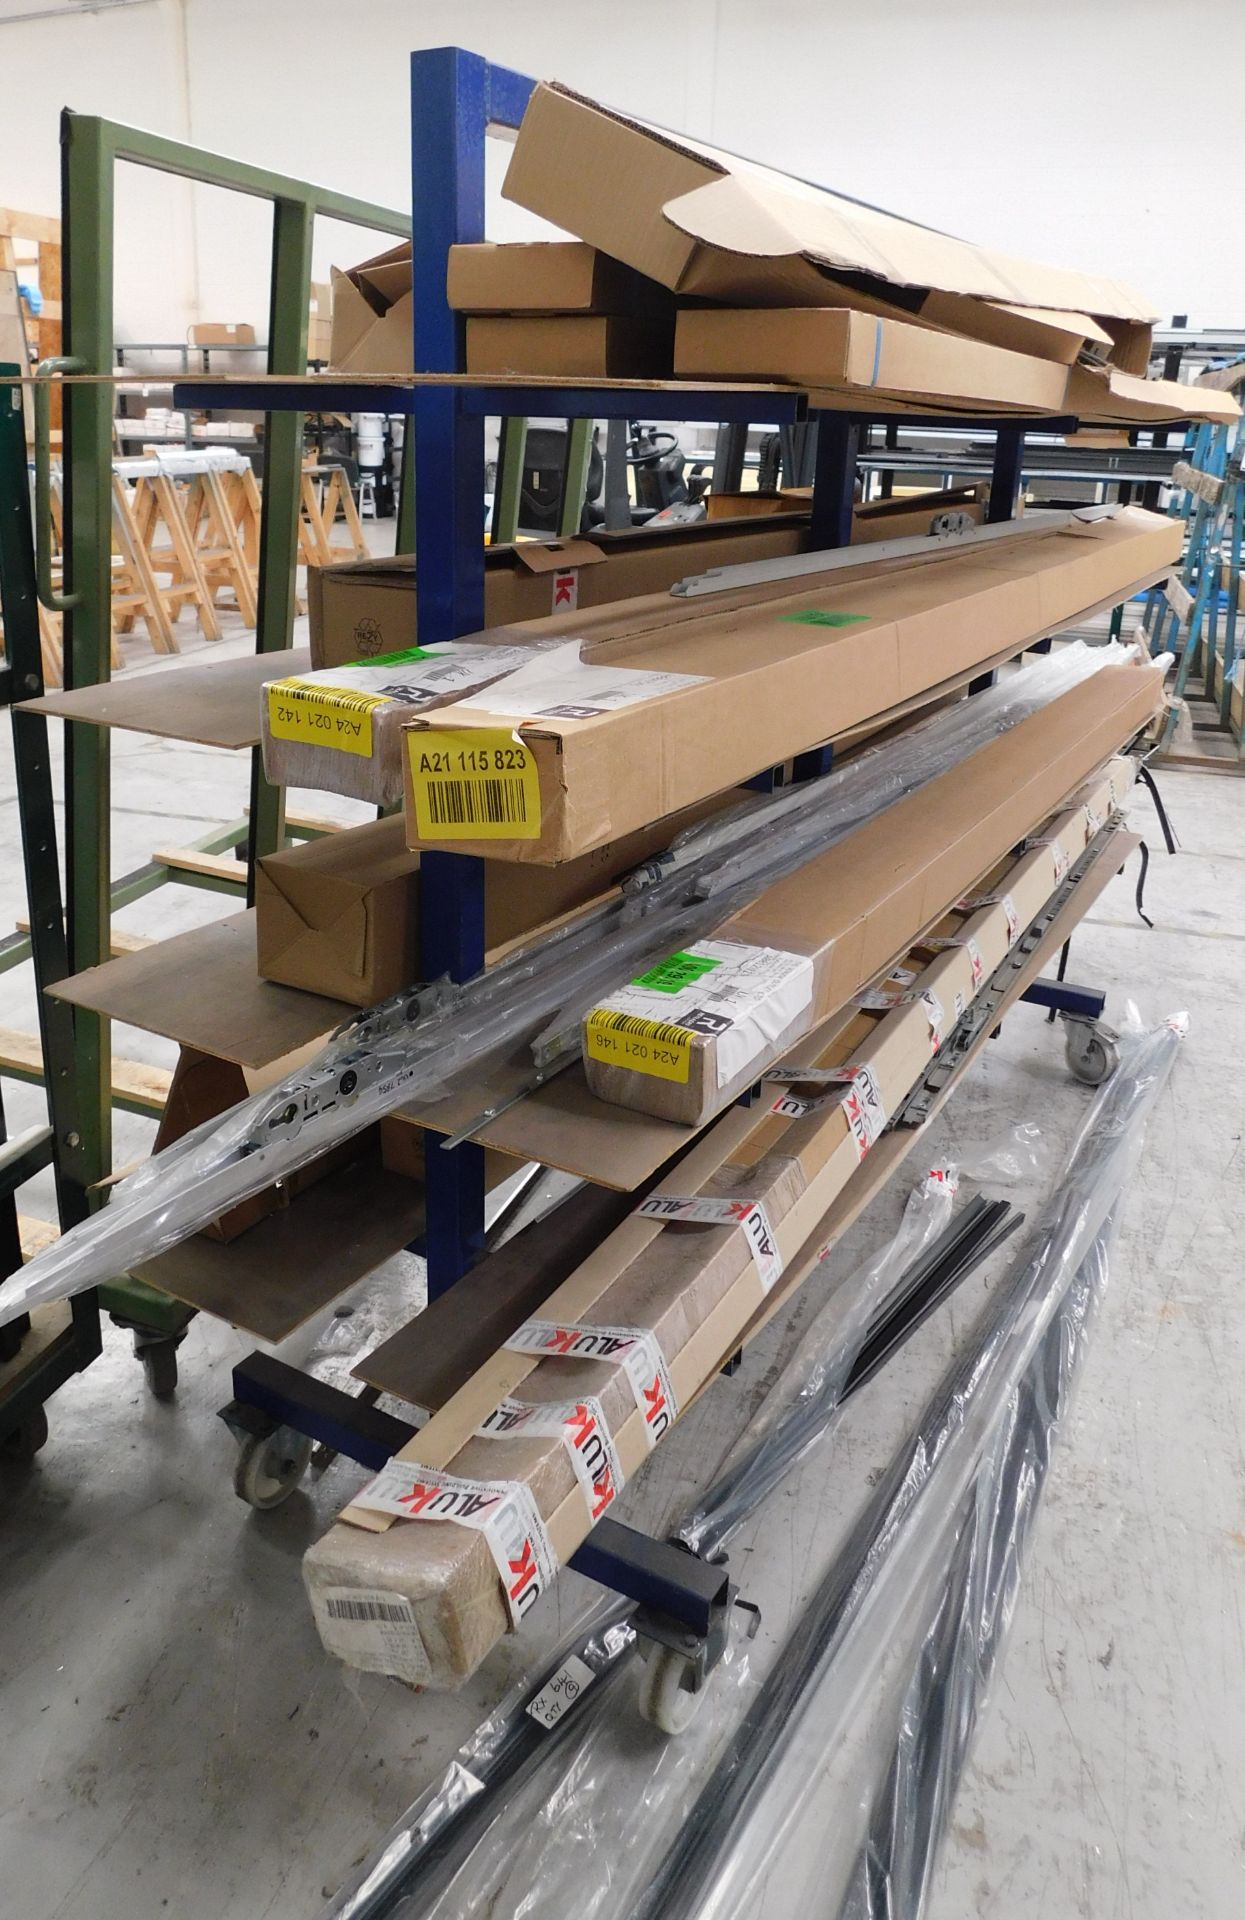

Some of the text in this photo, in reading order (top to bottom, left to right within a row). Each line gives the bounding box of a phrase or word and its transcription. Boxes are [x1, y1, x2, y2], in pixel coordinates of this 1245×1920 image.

[277, 706, 361, 737] A24 021 142
[420, 749, 526, 773] A21 115 823
[596, 1034, 679, 1066] A24 021 146
[543, 1328, 638, 1356] ALUK
[396, 1482, 501, 1518] ALUK
